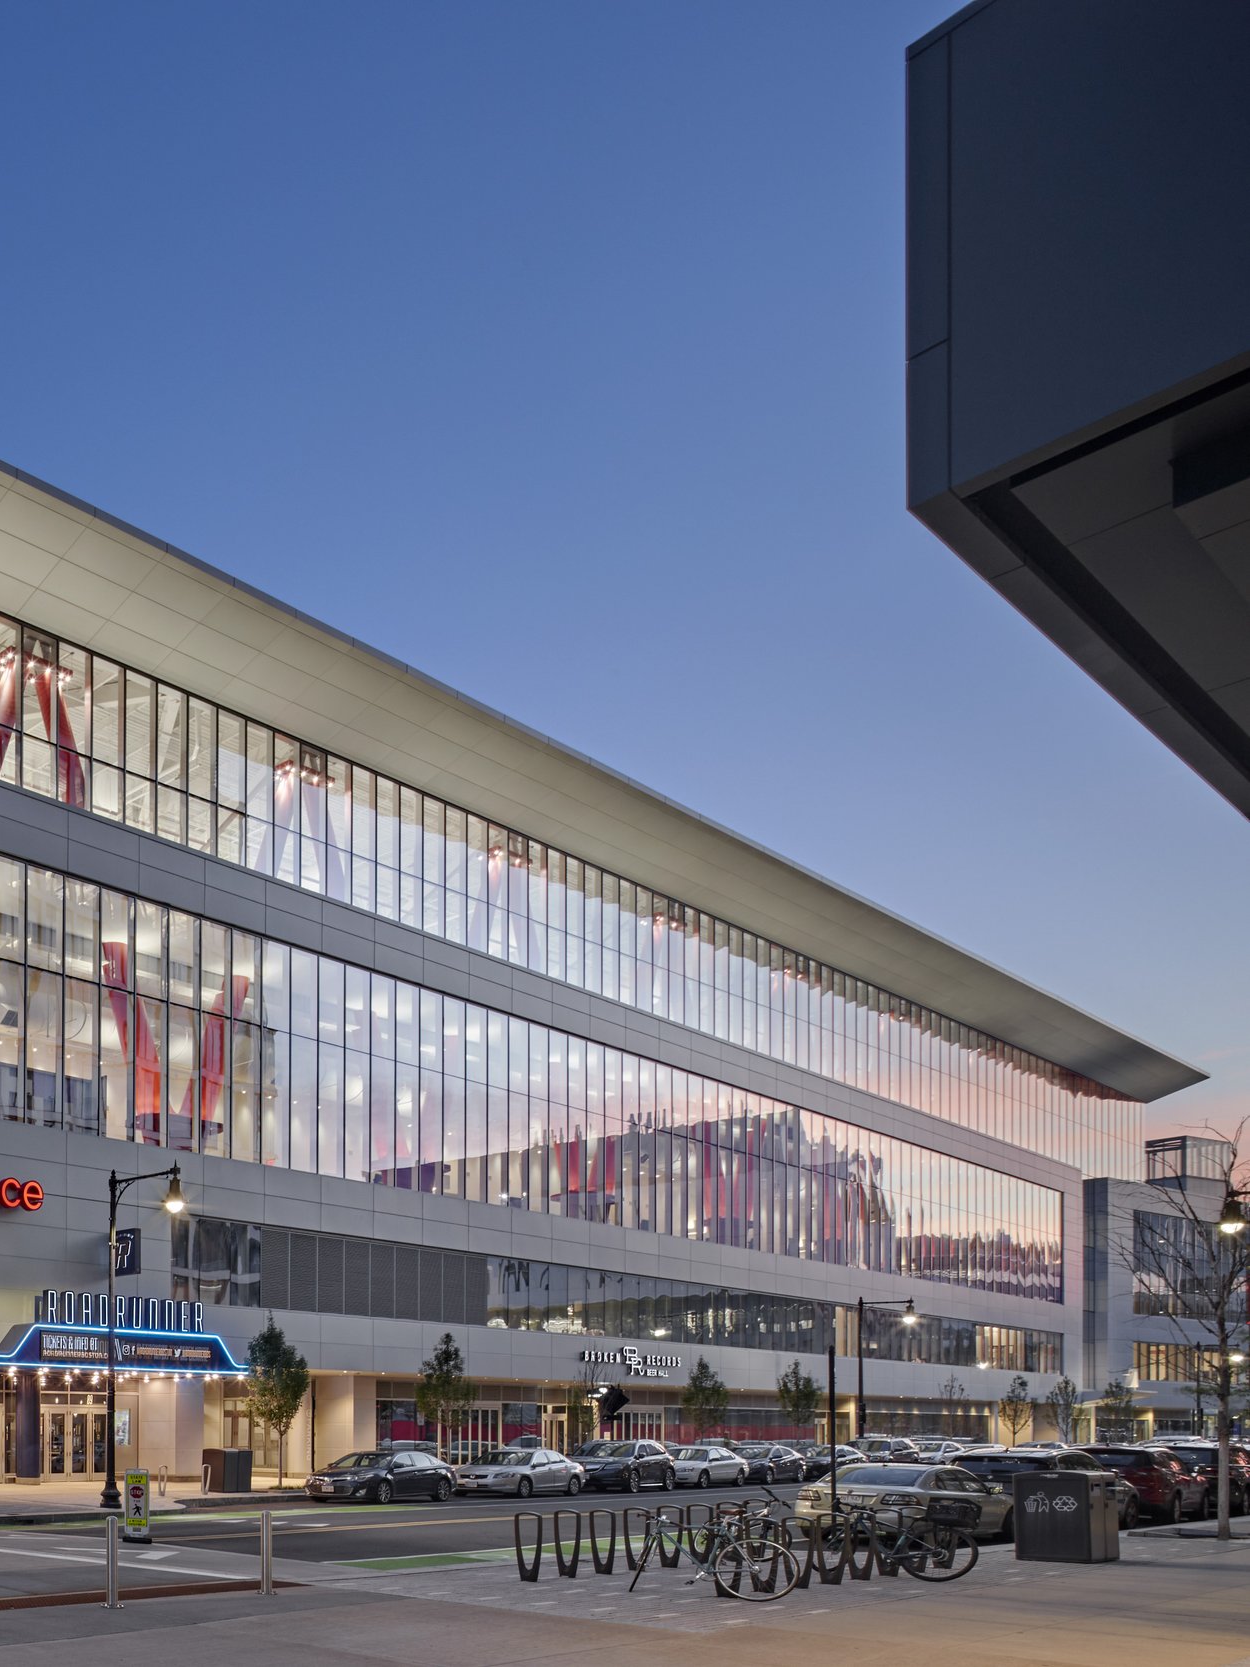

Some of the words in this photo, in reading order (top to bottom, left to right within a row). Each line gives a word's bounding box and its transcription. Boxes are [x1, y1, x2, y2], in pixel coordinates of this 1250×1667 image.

[44, 1289, 204, 1333] ROADRUNNER
[42, 1335, 67, 1350] TICKETS
[584, 1350, 621, 1364] BROKEN
[646, 1355, 682, 1368] RECORDS
[646, 1368, 657, 1377] BEER
